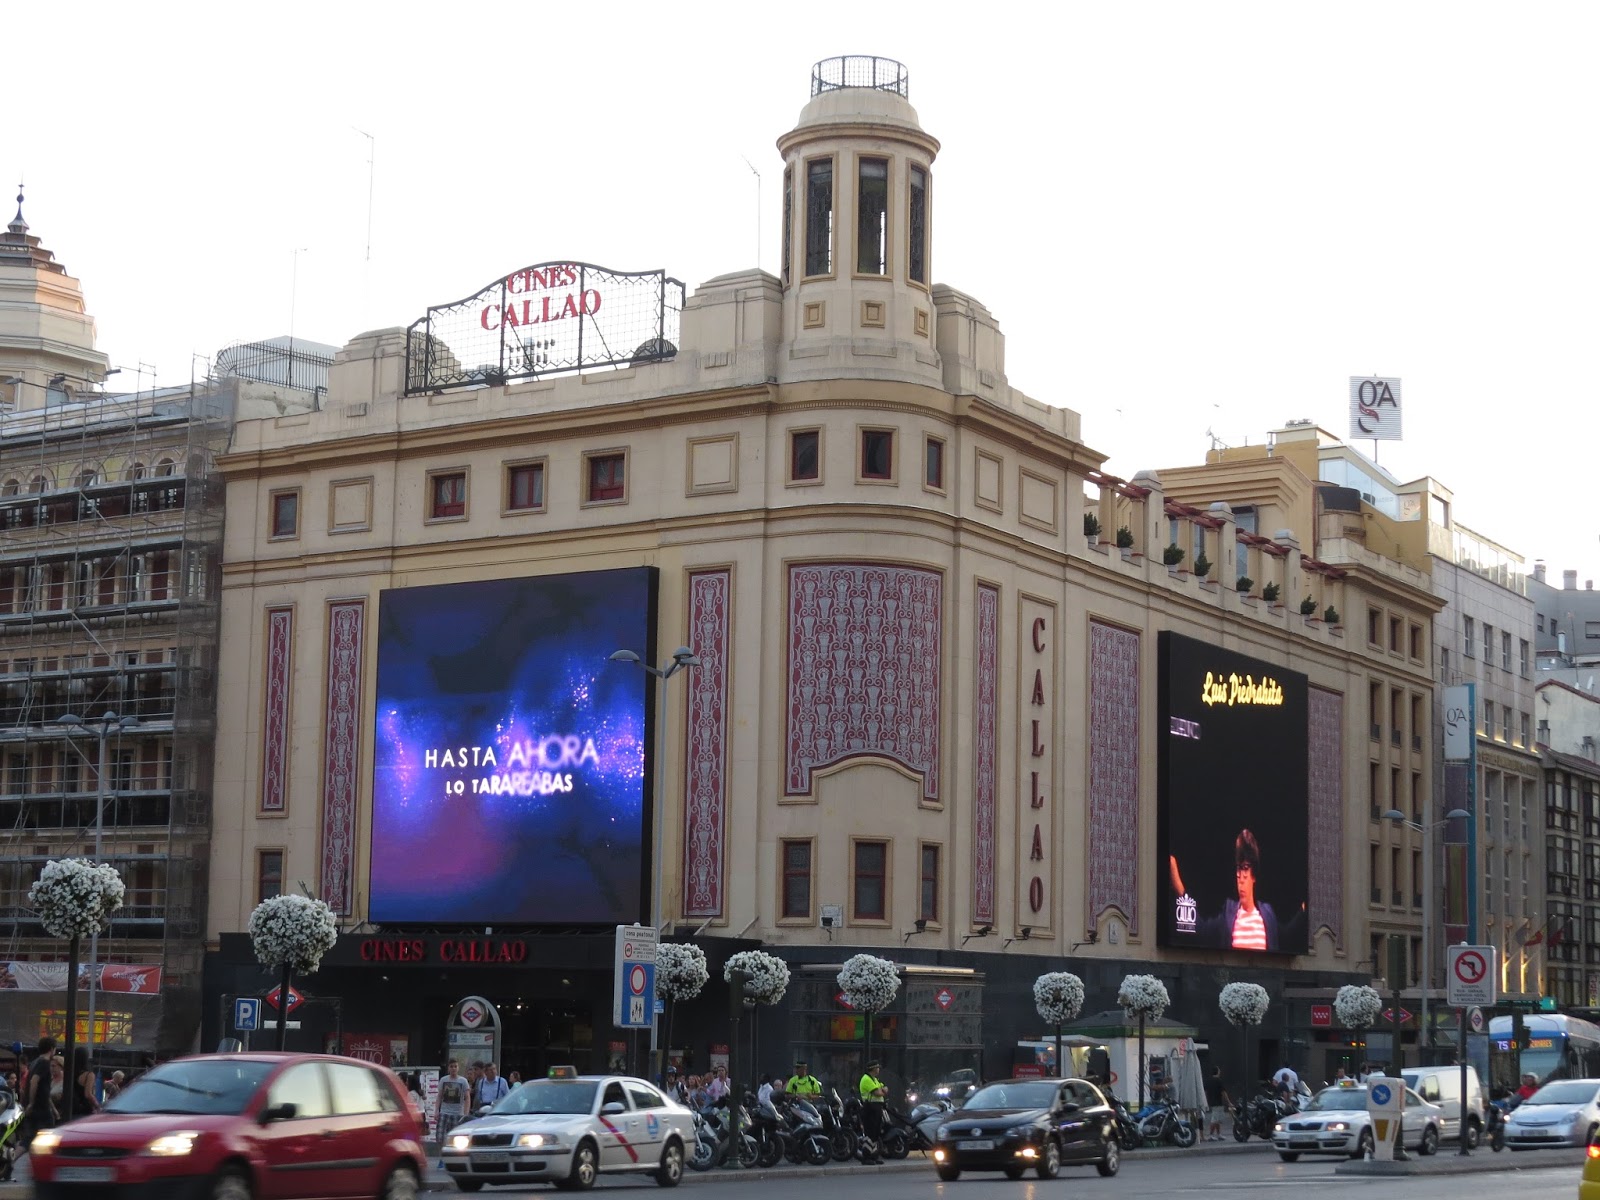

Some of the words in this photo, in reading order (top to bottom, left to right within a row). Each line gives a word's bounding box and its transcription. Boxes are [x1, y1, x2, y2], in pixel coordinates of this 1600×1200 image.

[507, 263, 577, 295] CINES
[481, 289, 602, 331] CALLAO
[1202, 671, 1228, 706] Luis
[1228, 672, 1283, 706] Piedrahita
[425, 746, 497, 768] HASTA
[507, 736, 599, 768] AHORA
[1030, 617, 1046, 913] CALLAO
[446, 780, 465, 794] LO
[360, 939, 425, 962] CINES
[440, 939, 527, 963] CALLAO
[239, 1003, 252, 1027] P
